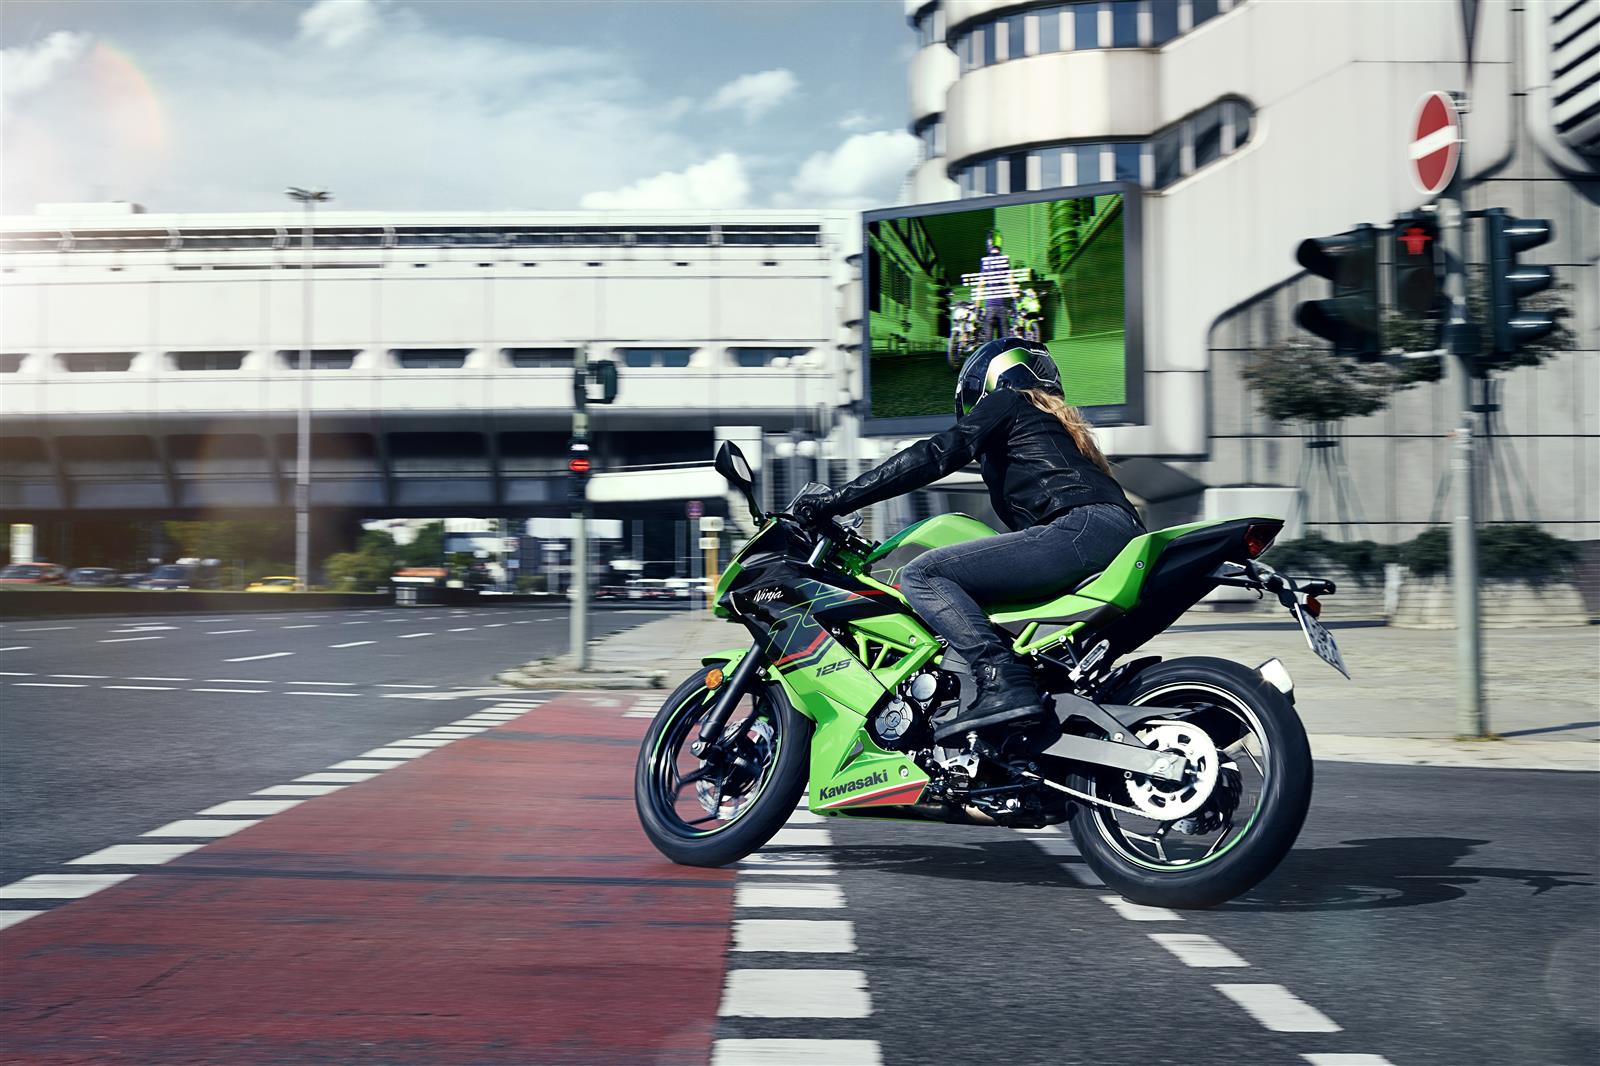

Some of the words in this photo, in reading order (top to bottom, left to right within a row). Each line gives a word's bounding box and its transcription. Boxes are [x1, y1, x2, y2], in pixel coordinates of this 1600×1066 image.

[753, 587, 784, 603] Ninja
[816, 659, 852, 677] 125
[819, 769, 889, 801] Kawasaki
